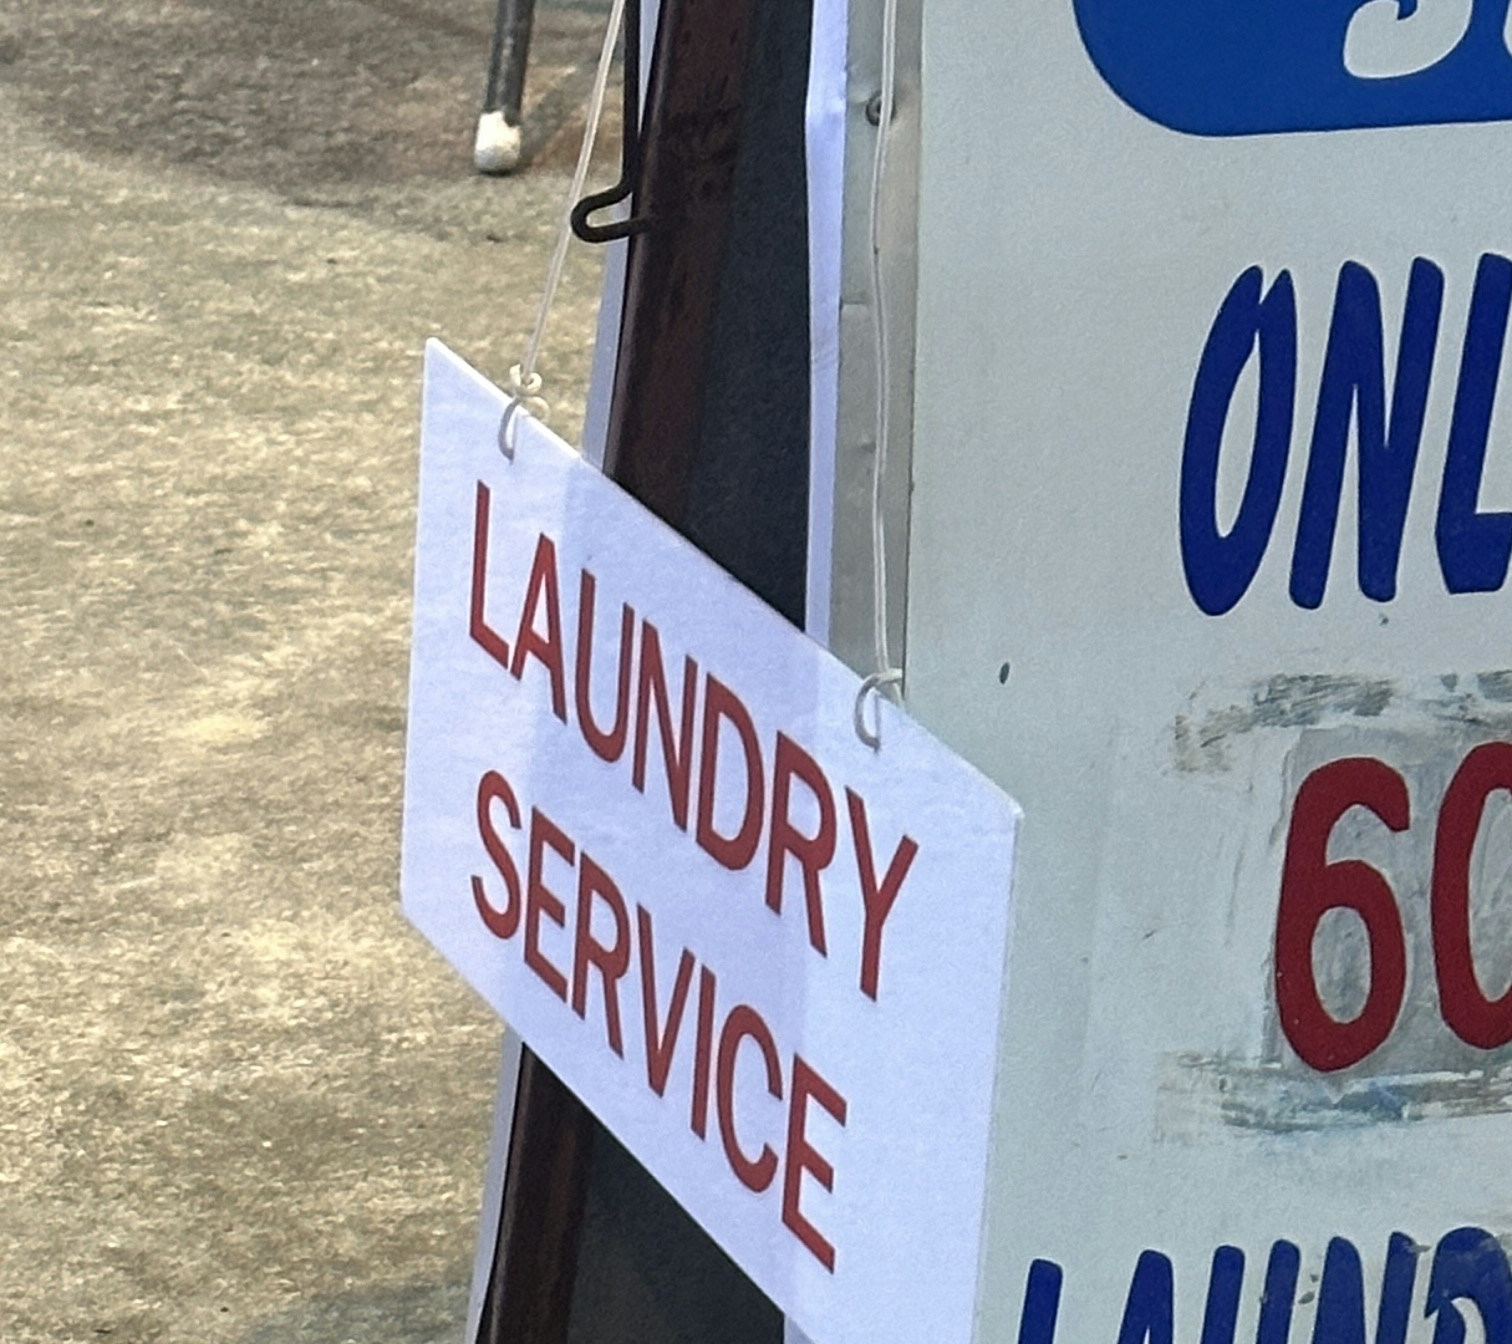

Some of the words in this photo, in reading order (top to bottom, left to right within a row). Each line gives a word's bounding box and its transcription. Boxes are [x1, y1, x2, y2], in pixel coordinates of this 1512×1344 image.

[1180, 253, 1512, 615] ONL
[469, 481, 919, 1000] LAUNDRY
[1275, 741, 1512, 1072] 60
[471, 771, 847, 1273] SERVICE
